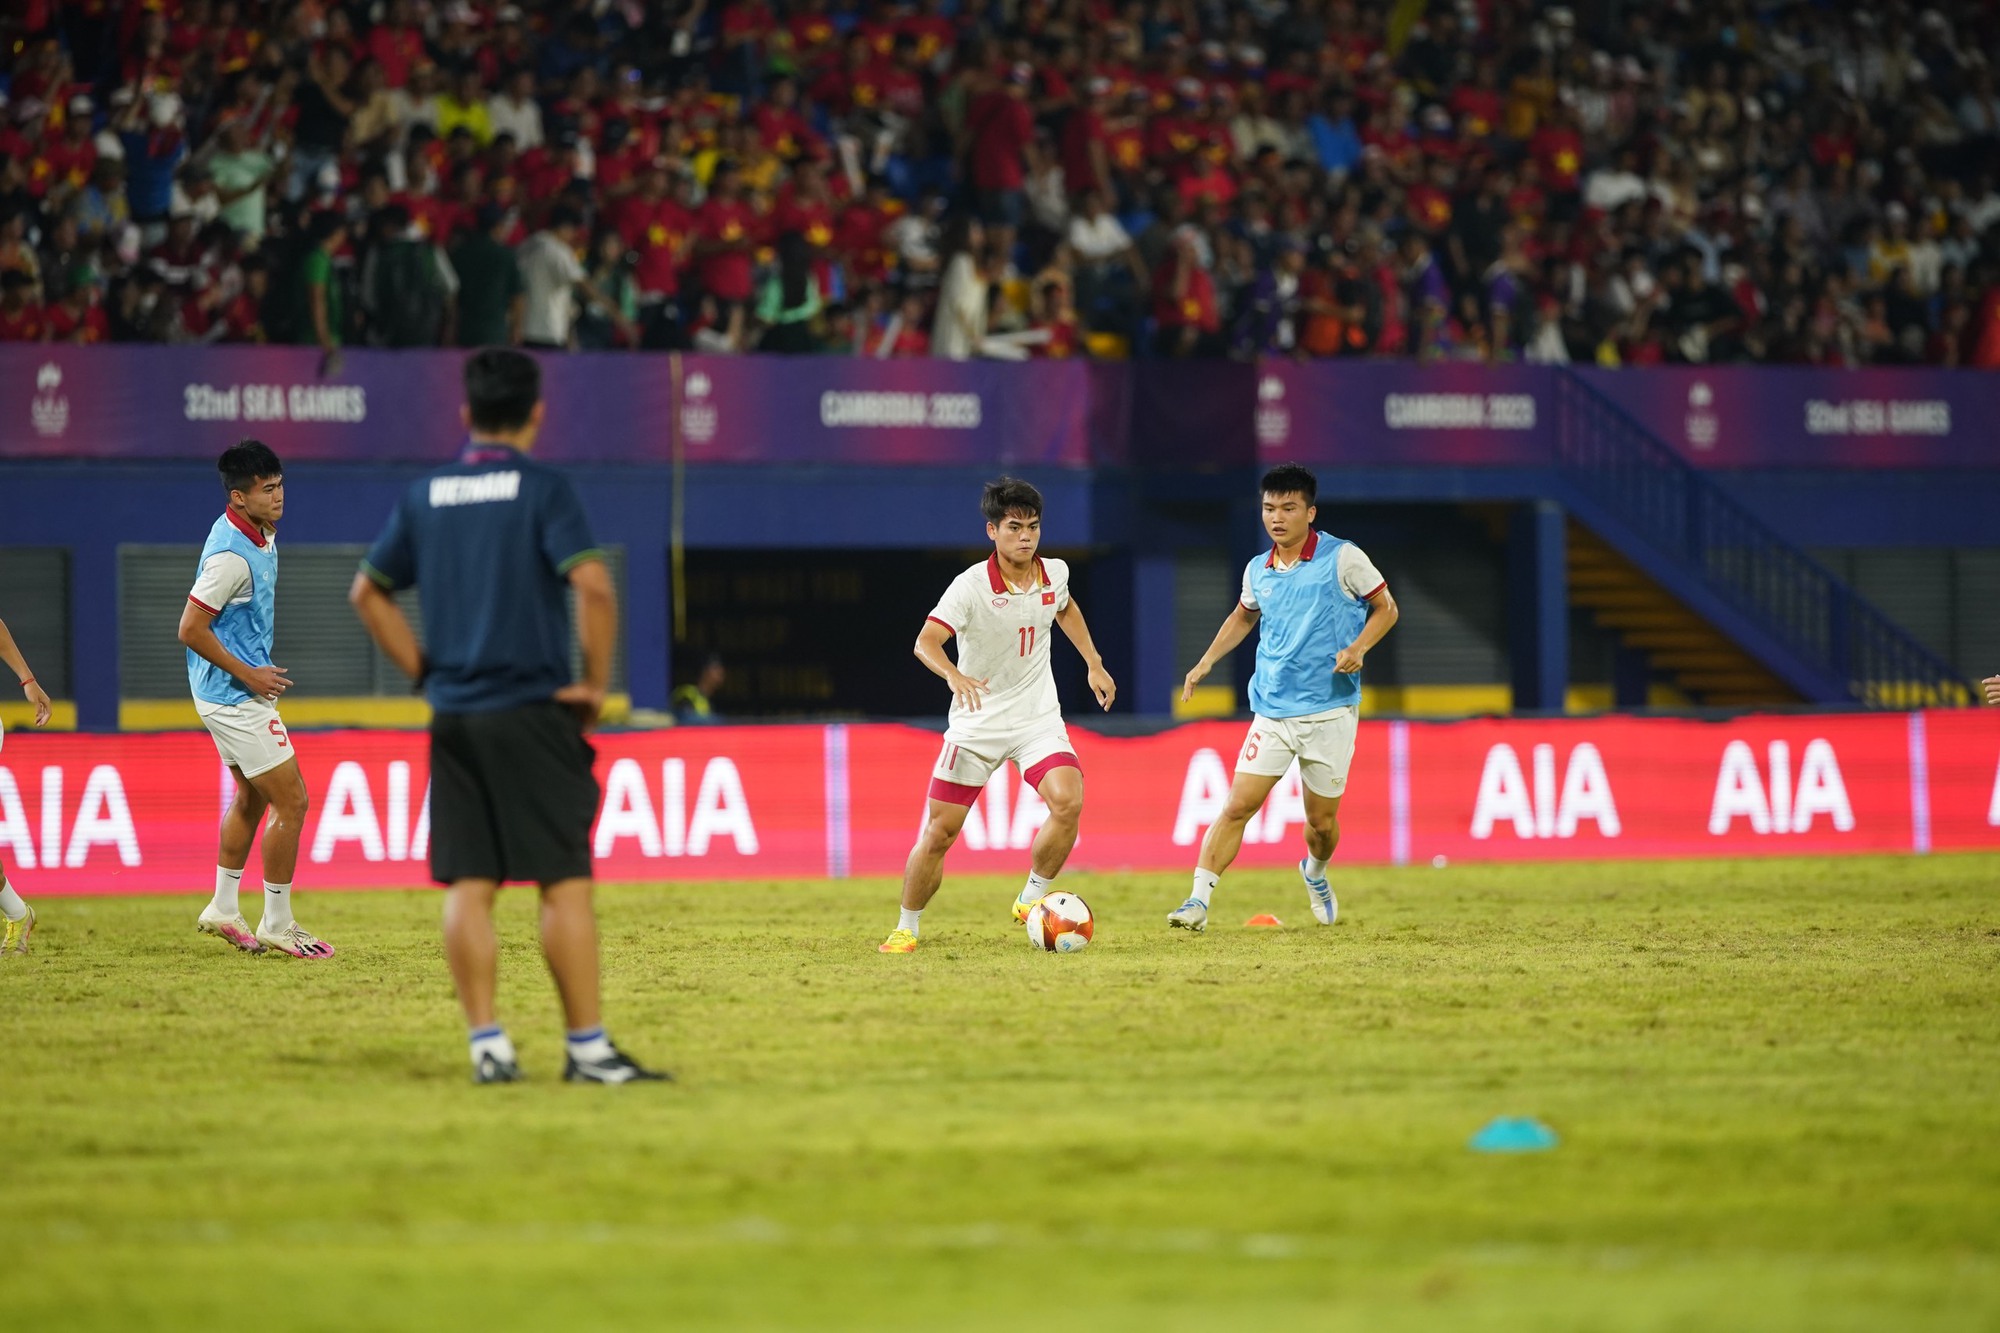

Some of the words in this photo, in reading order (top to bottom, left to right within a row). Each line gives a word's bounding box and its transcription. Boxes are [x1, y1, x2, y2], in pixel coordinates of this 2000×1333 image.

[184, 383, 240, 421] 32nd
[243, 384, 286, 421] SEA
[288, 385, 366, 422] GAMES
[820, 390, 927, 427] CAMBODIA
[929, 393, 981, 429] 2023
[1384, 393, 1484, 429] CAMBODIA
[1486, 394, 1536, 430] 2023
[1851, 400, 1885, 435] SEA
[1889, 400, 1951, 436] GAMES
[429, 470, 521, 508] VIETNAM
[1019, 626, 1035, 657] 11
[268, 719, 288, 747] 5
[1241, 731, 1261, 761] 16
[941, 742, 959, 770] 11
[1172, 748, 1306, 846] AA
[1469, 742, 1622, 839] AIA
[1708, 738, 1855, 834] AIA
[309, 760, 431, 863] AI
[594, 756, 760, 858] AIA
